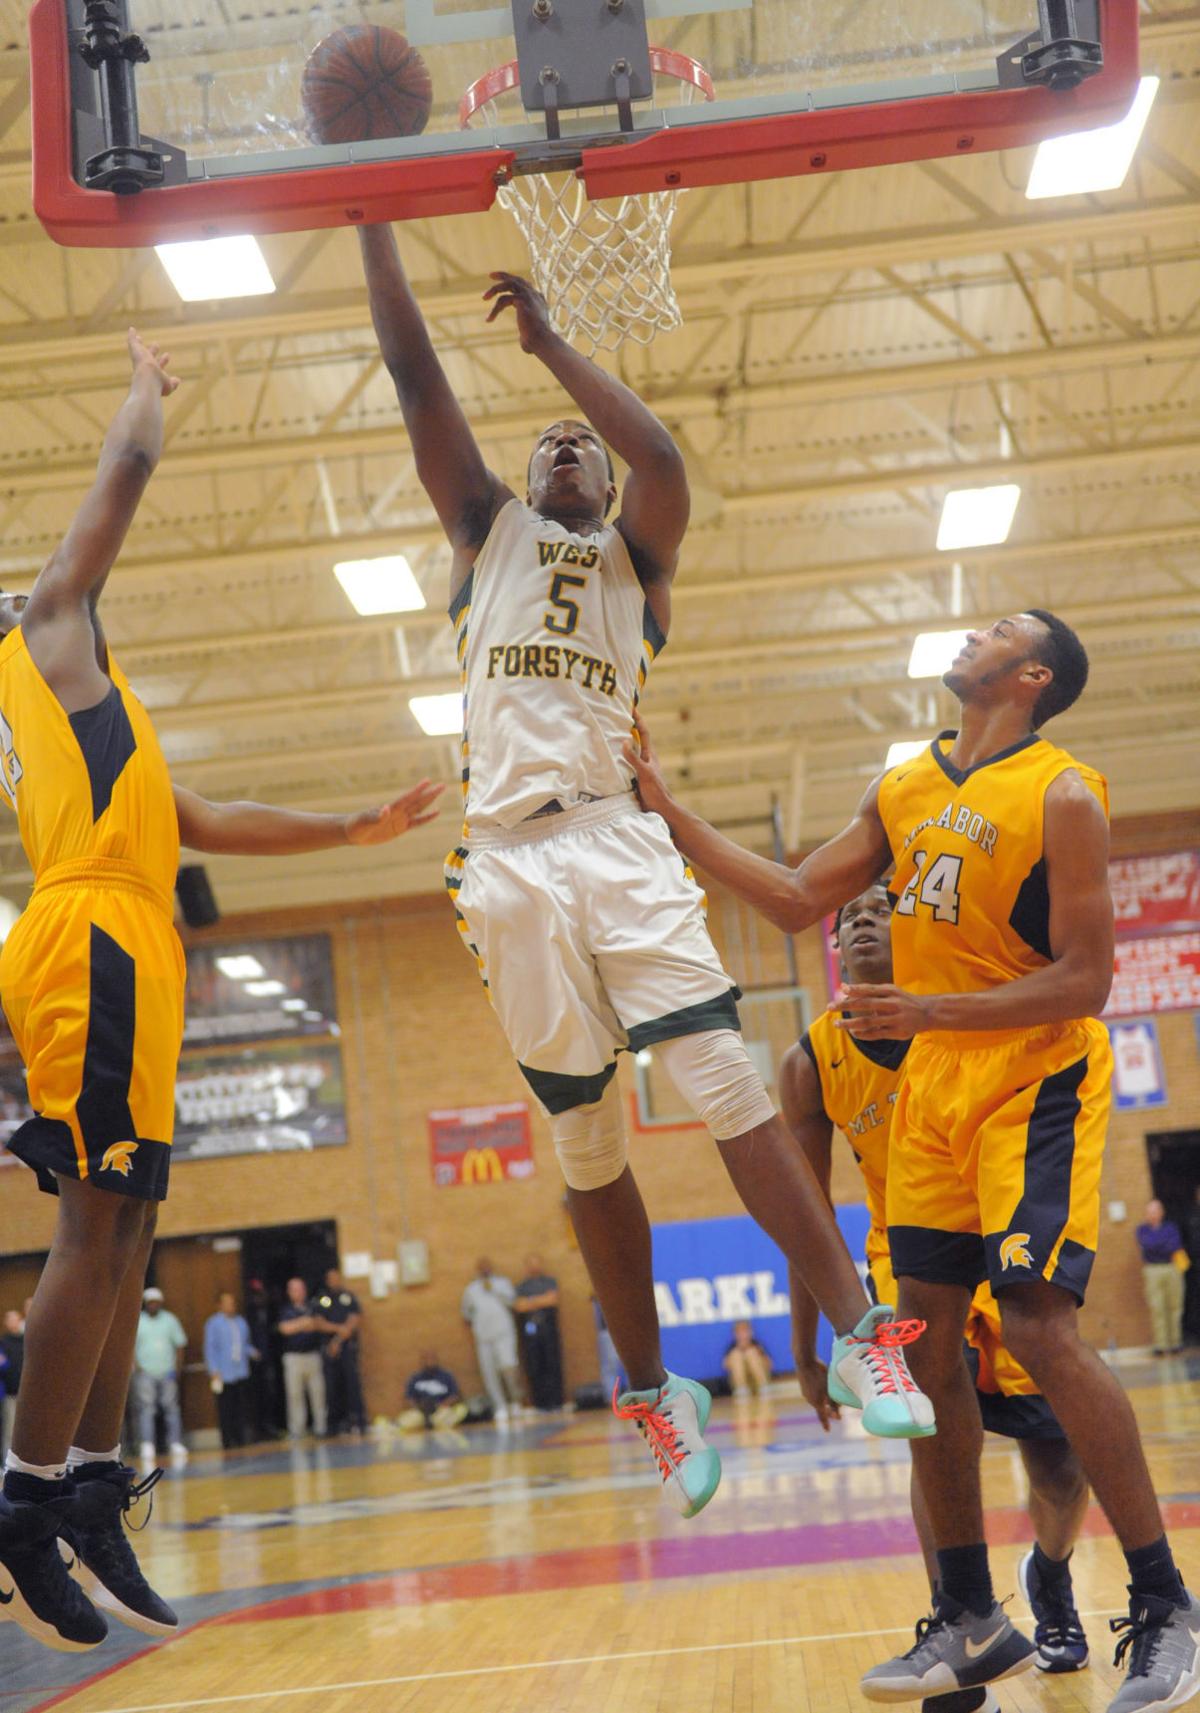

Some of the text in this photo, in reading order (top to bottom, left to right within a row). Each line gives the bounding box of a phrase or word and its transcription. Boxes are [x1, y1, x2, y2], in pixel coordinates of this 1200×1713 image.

[537, 541, 603, 572] WES
[545, 572, 587, 636] 5
[487, 643, 618, 697] FORSYTH
